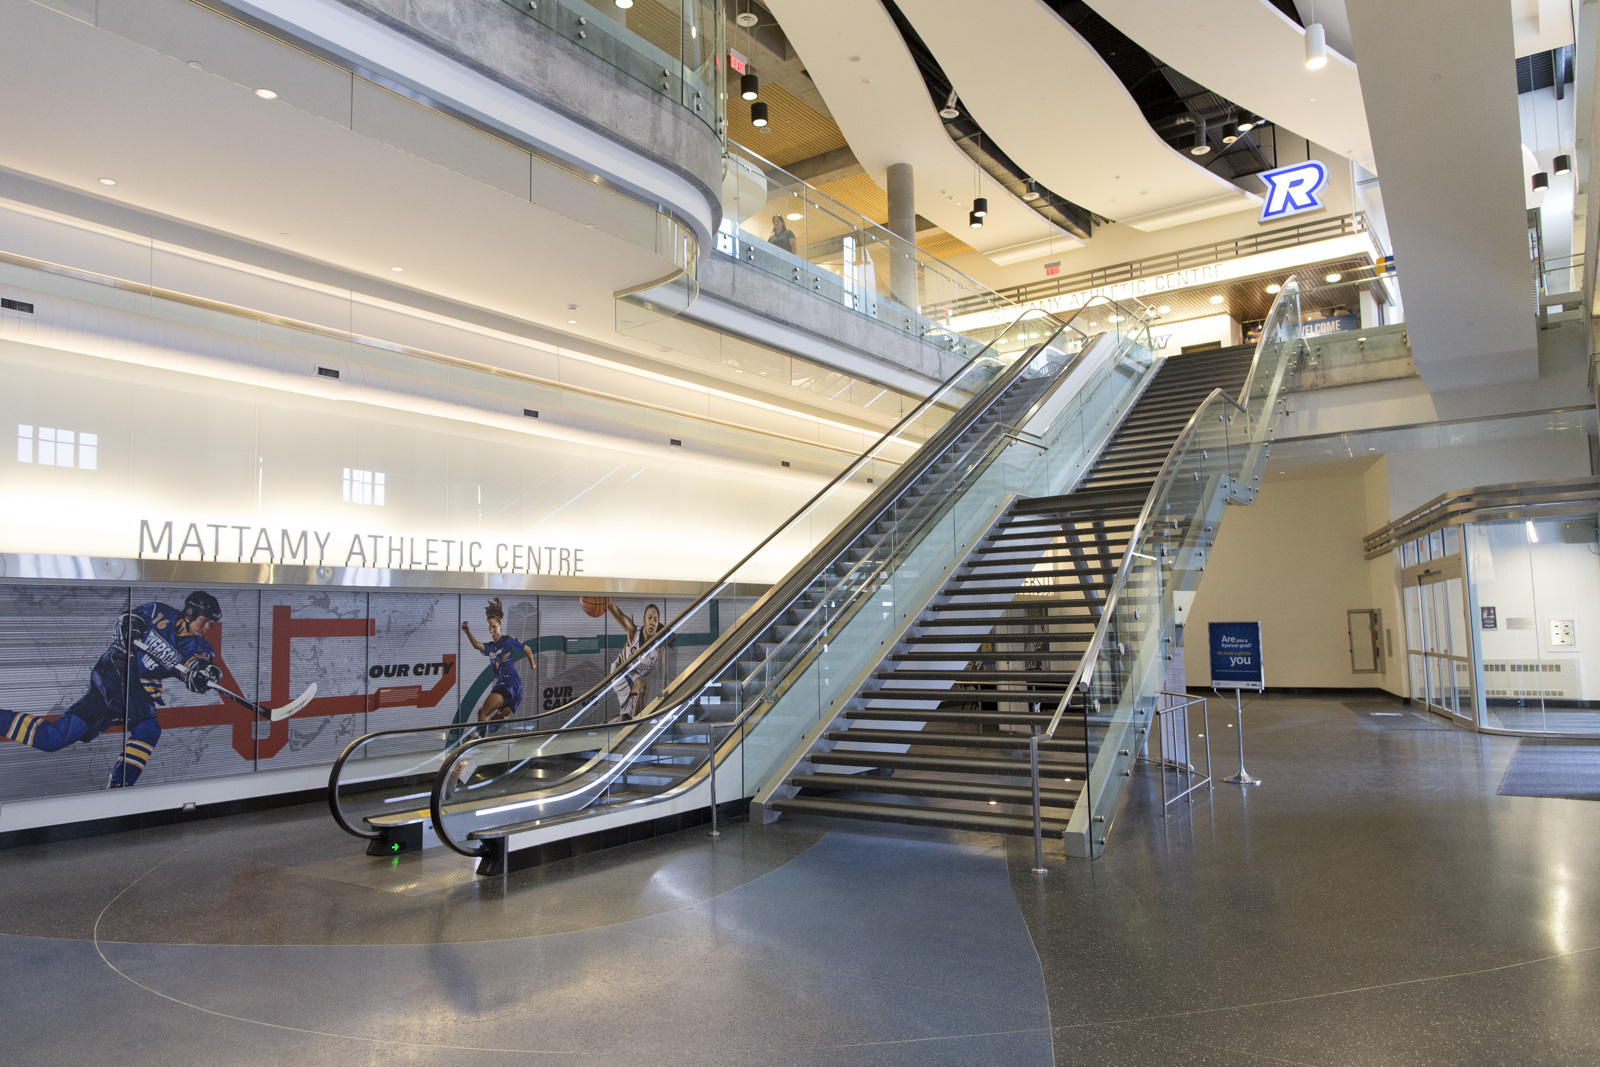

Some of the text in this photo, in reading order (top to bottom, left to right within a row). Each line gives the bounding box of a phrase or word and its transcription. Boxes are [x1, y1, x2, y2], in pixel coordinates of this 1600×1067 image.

[1256, 160, 1328, 222] R
[139, 519, 584, 572] MATTAMY ATHLETIC CENTRE
[152, 613, 170, 629] 16
[1230, 656, 1251, 667] you
[369, 662, 454, 678] OUR CITY
[543, 686, 573, 699] OUR
